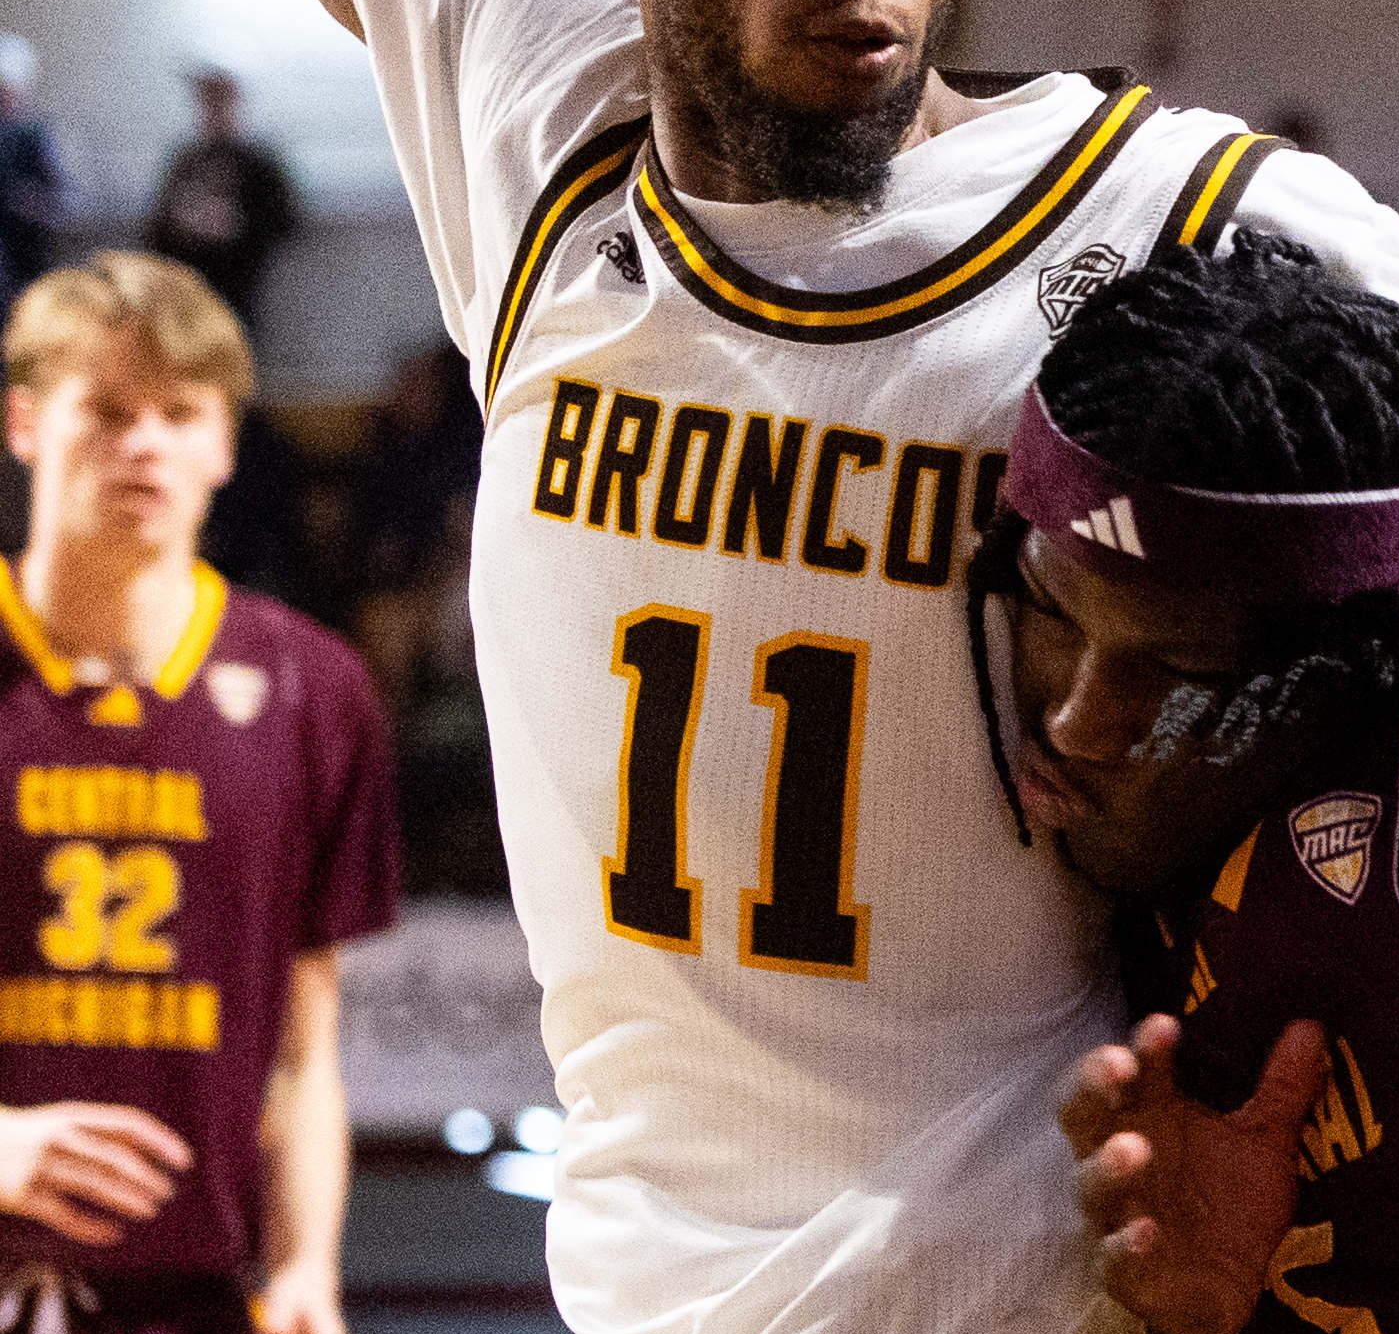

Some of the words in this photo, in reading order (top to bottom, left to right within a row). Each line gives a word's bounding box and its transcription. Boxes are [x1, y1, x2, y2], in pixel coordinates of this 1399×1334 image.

[601, 602, 870, 981] 11
[1298, 821, 1372, 863] MAC
[39, 842, 180, 969] 32
